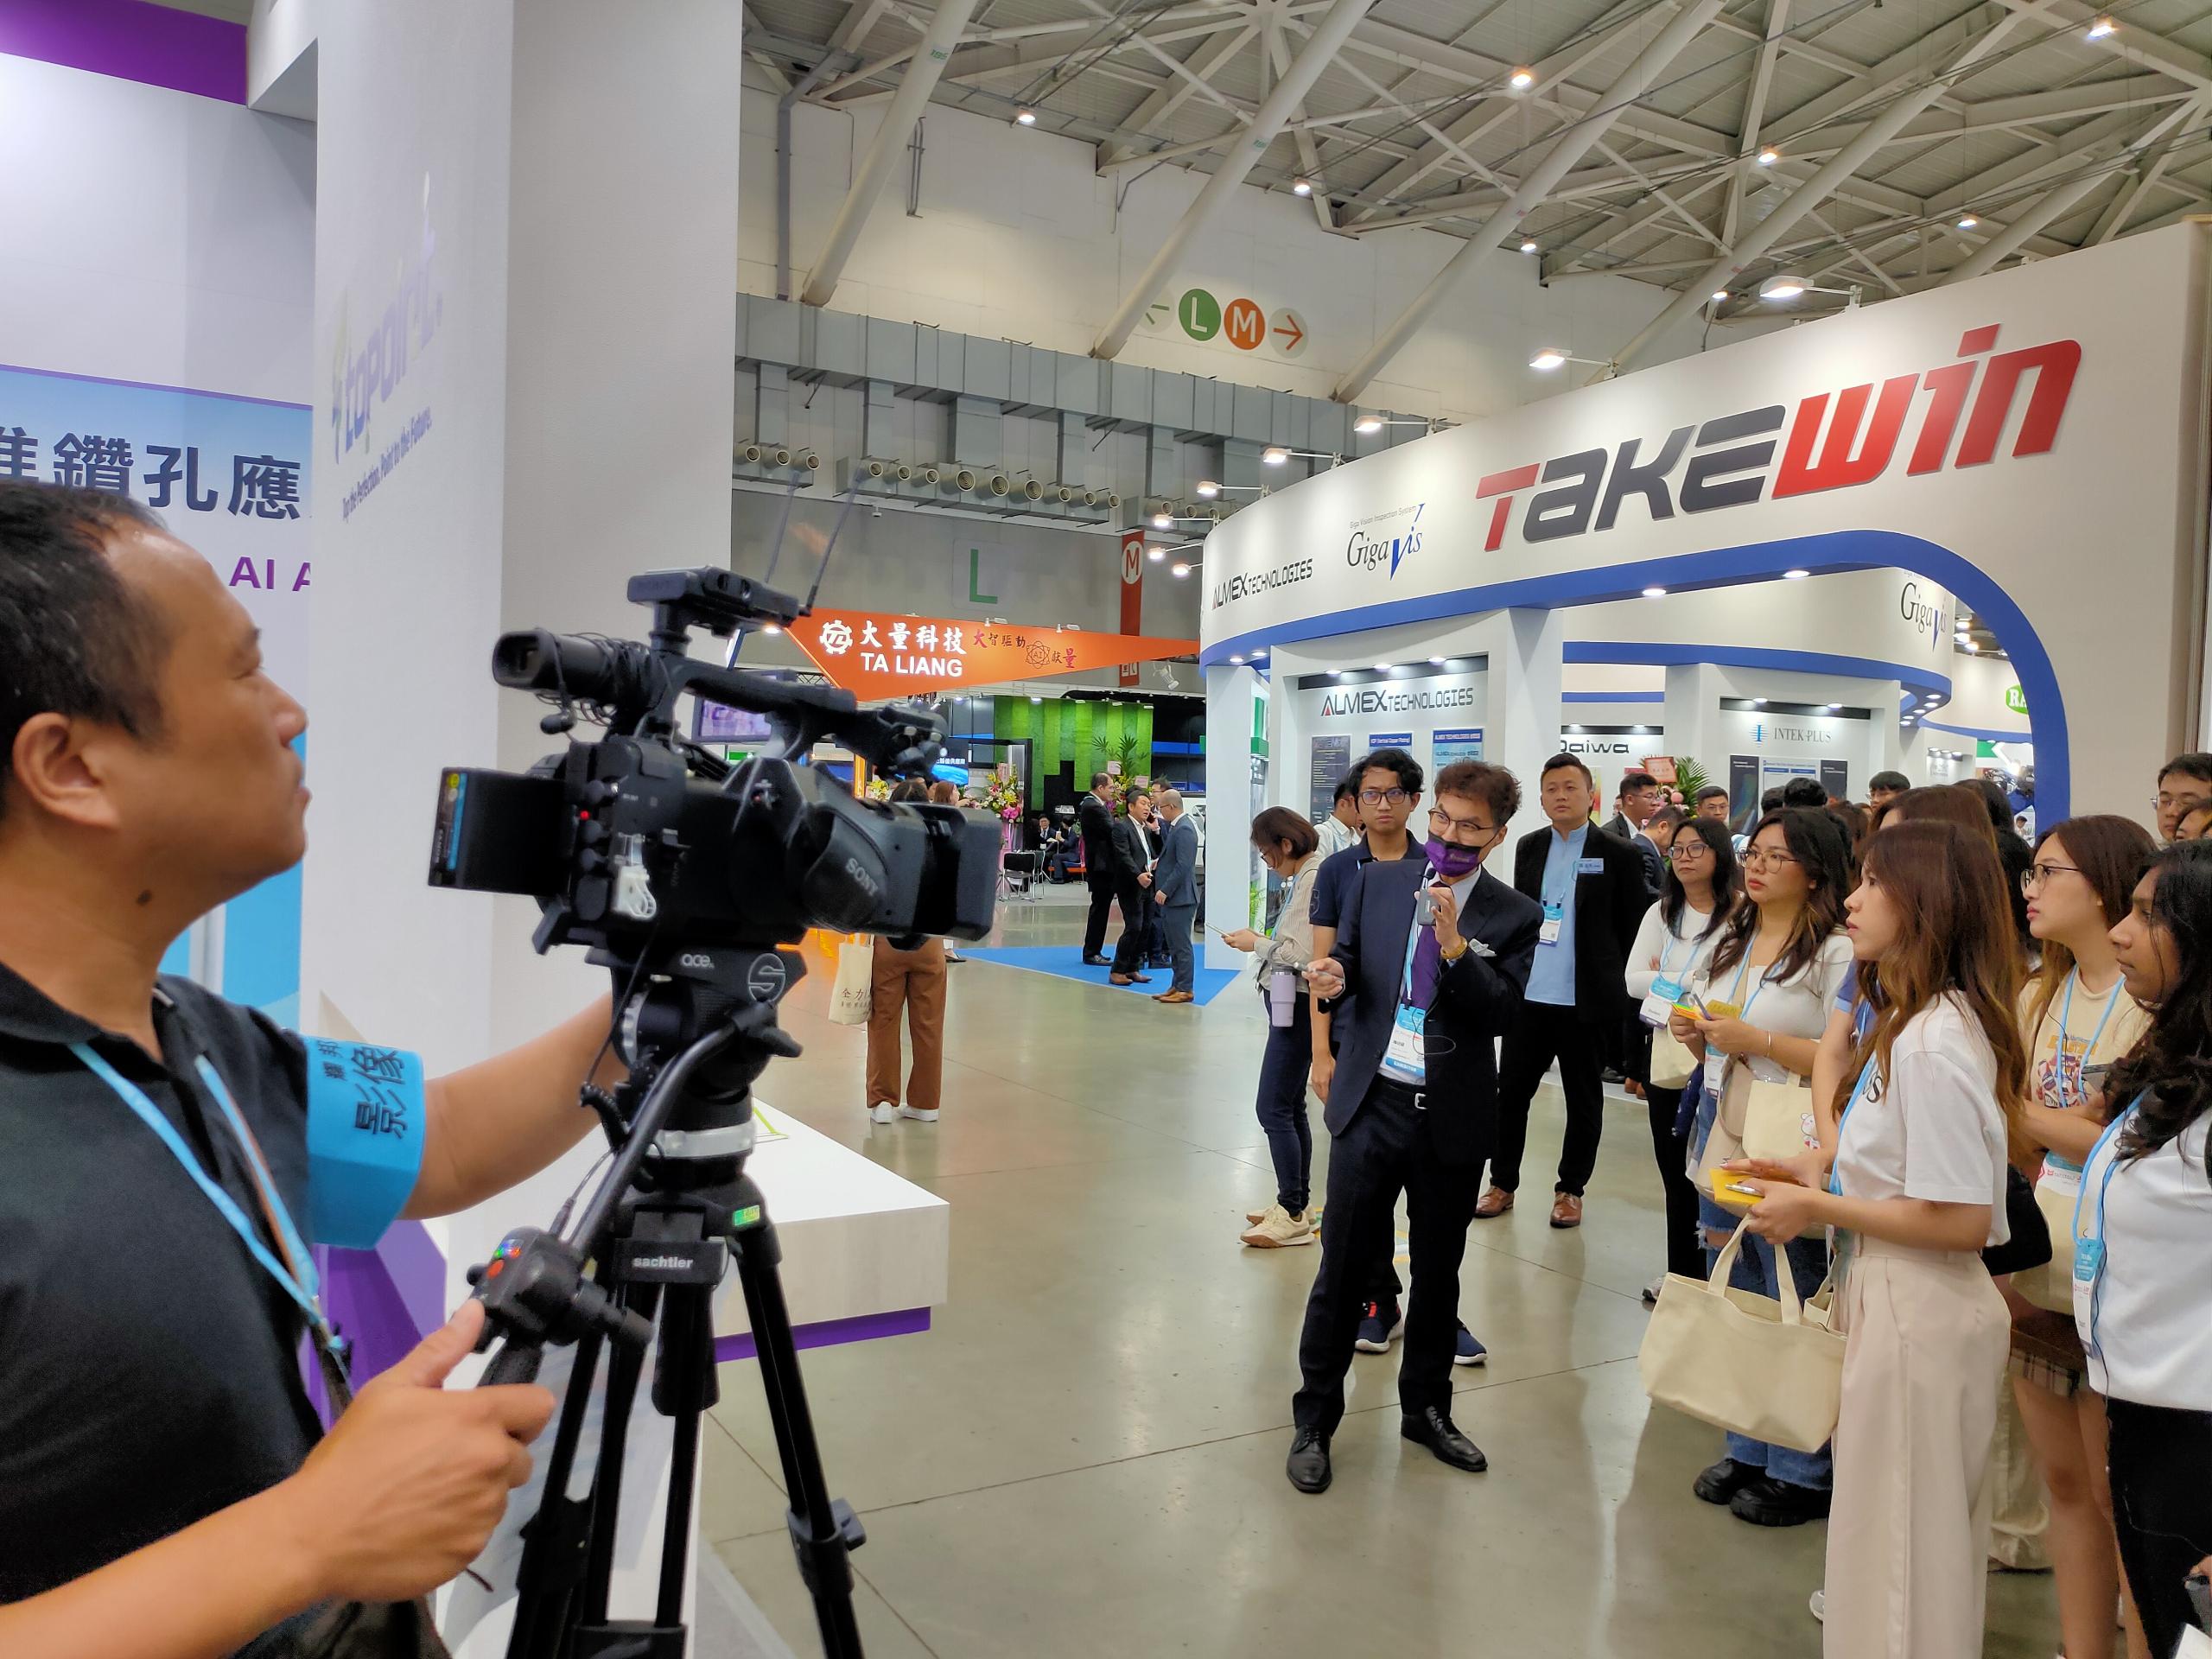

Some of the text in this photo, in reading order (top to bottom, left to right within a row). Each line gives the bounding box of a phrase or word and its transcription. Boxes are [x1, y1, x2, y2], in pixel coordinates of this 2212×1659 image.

[1191, 296, 1257, 343] L M
[229, 556, 276, 590] AI
[969, 549, 998, 604] L
[1126, 547, 1140, 578] M
[1247, 558, 1313, 595] TECHNOLOGIES
[860, 620, 967, 655] 大量科技
[860, 652, 963, 677] TA LIANG
[1320, 687, 1474, 717] ALMEX TECHNOLOGIES
[846, 857, 879, 897] SONY
[352, 1046, 408, 1141] 影像
[632, 1255, 694, 1268] sachtler
